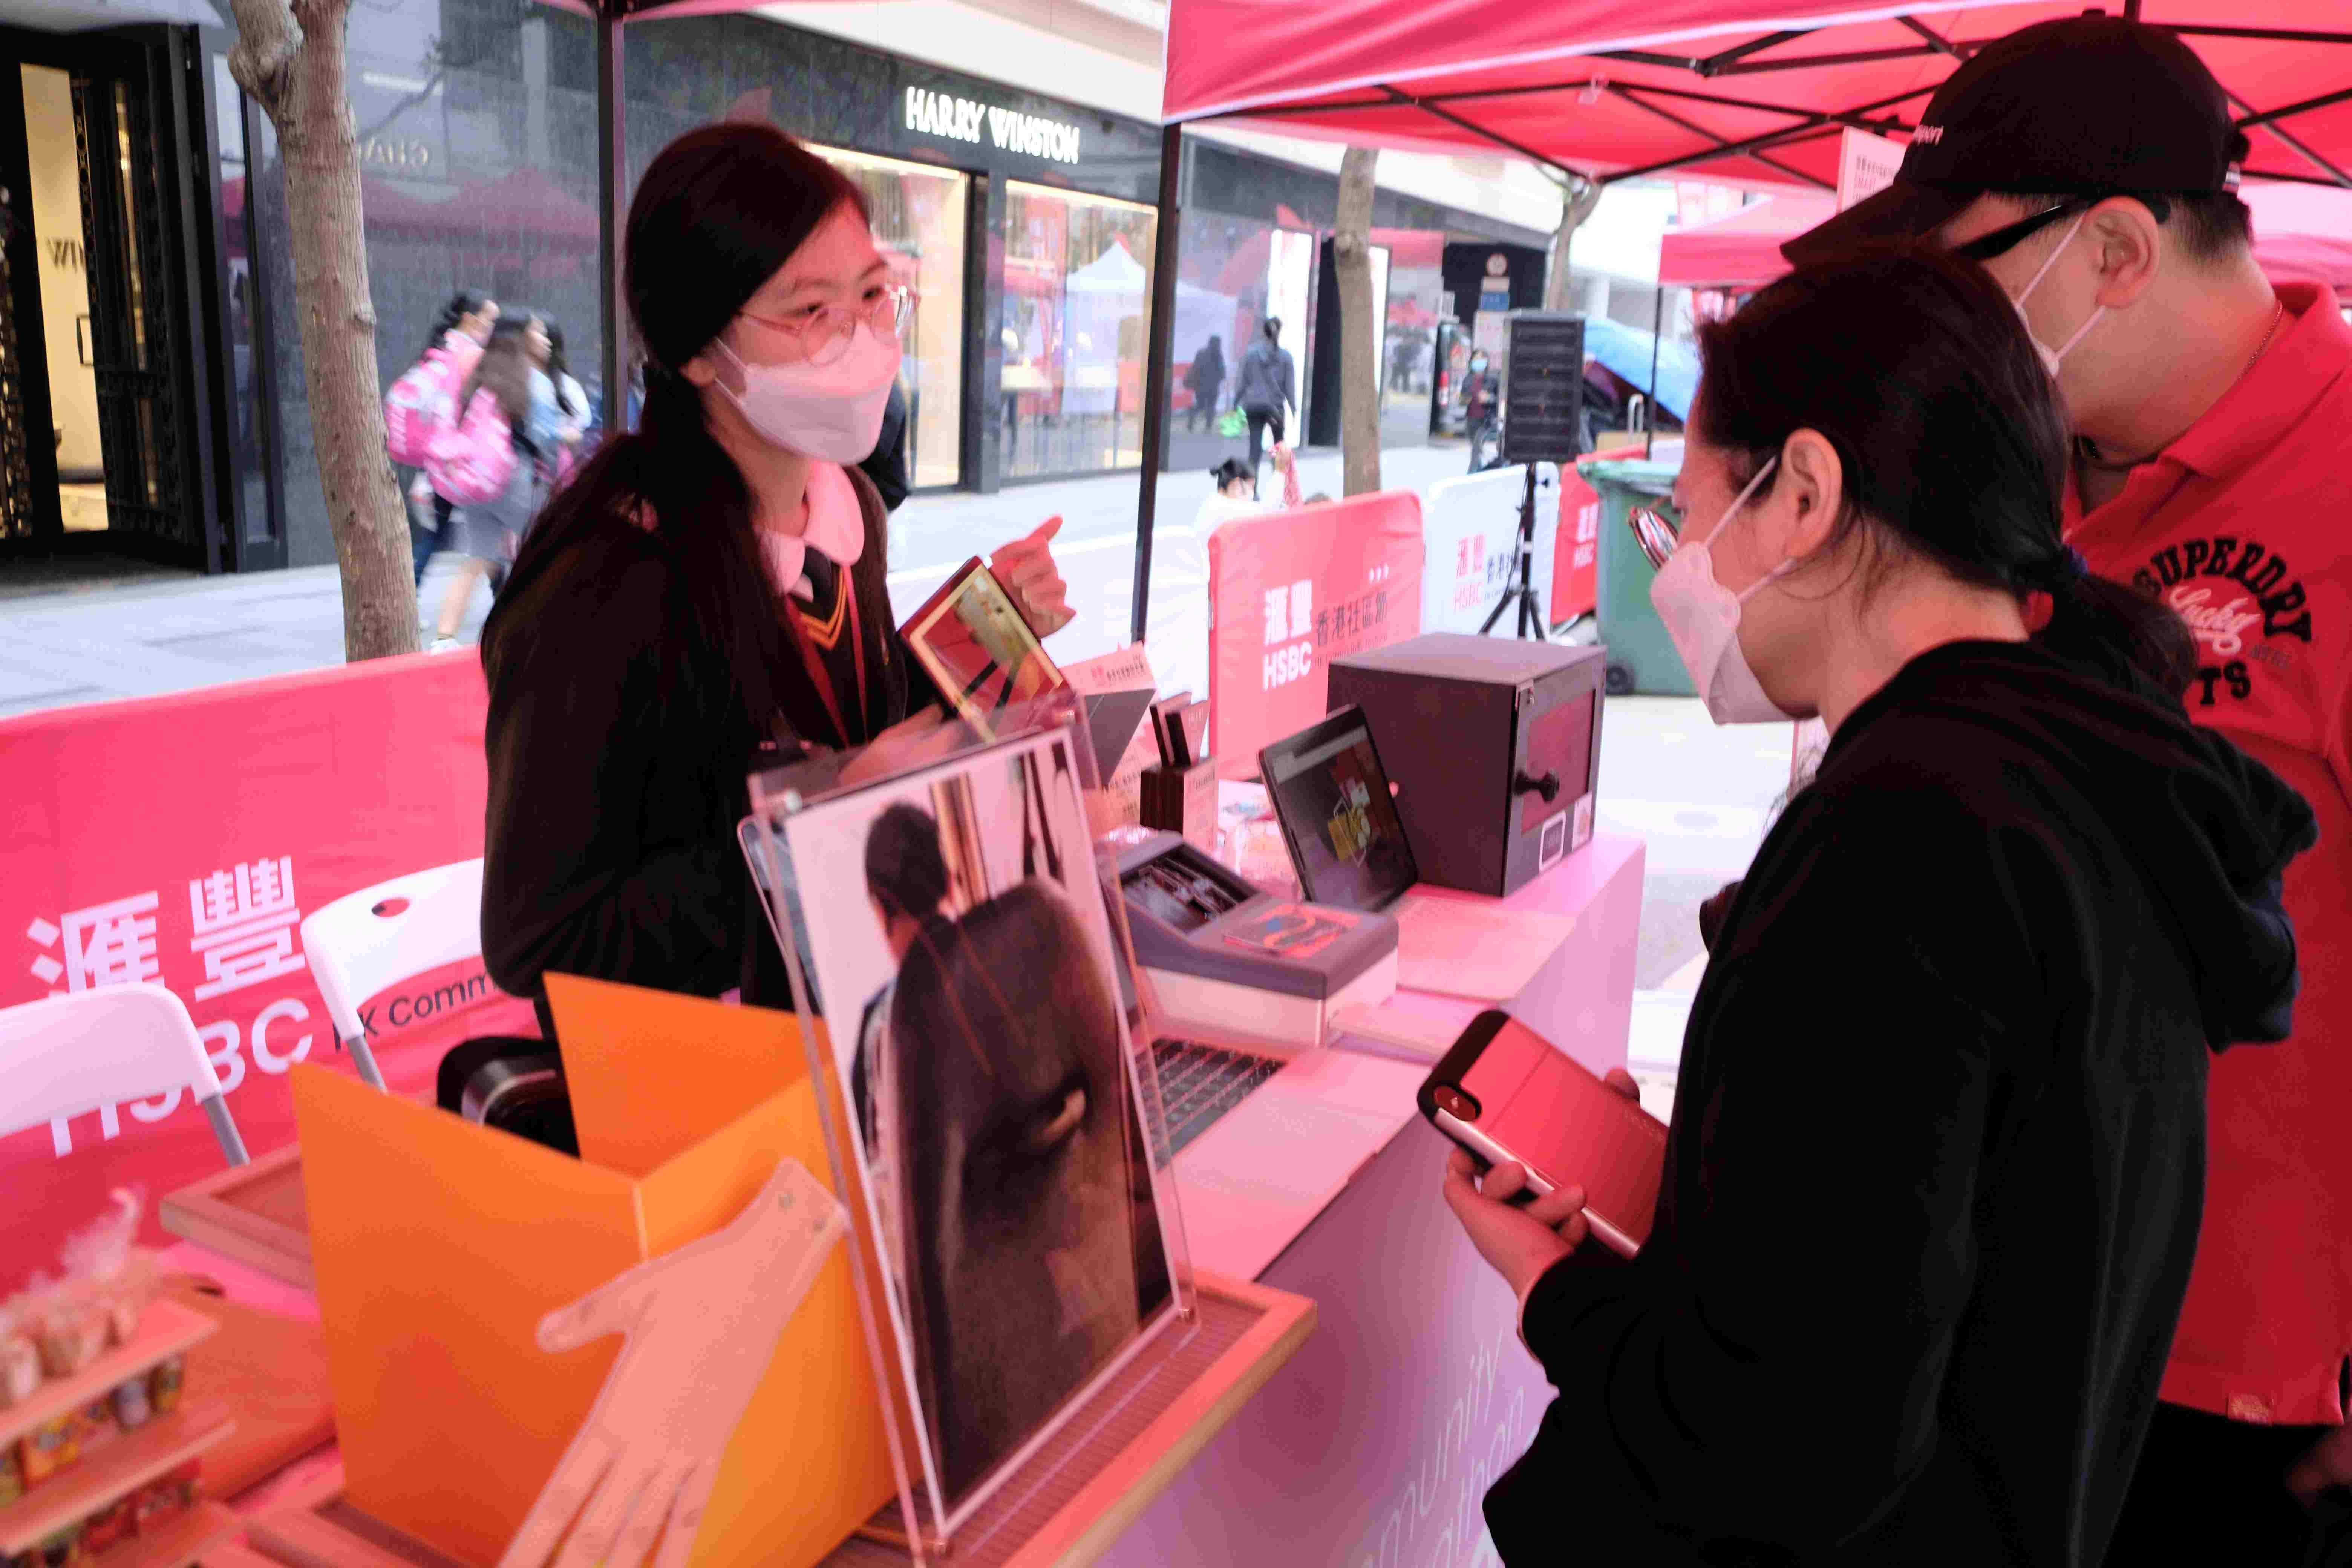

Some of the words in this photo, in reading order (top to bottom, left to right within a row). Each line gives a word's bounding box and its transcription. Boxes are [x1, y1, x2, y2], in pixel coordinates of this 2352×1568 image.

[906, 86, 986, 144] HARRY
[988, 106, 1080, 164] WINSTON
[1262, 641, 1312, 691] HSBC
